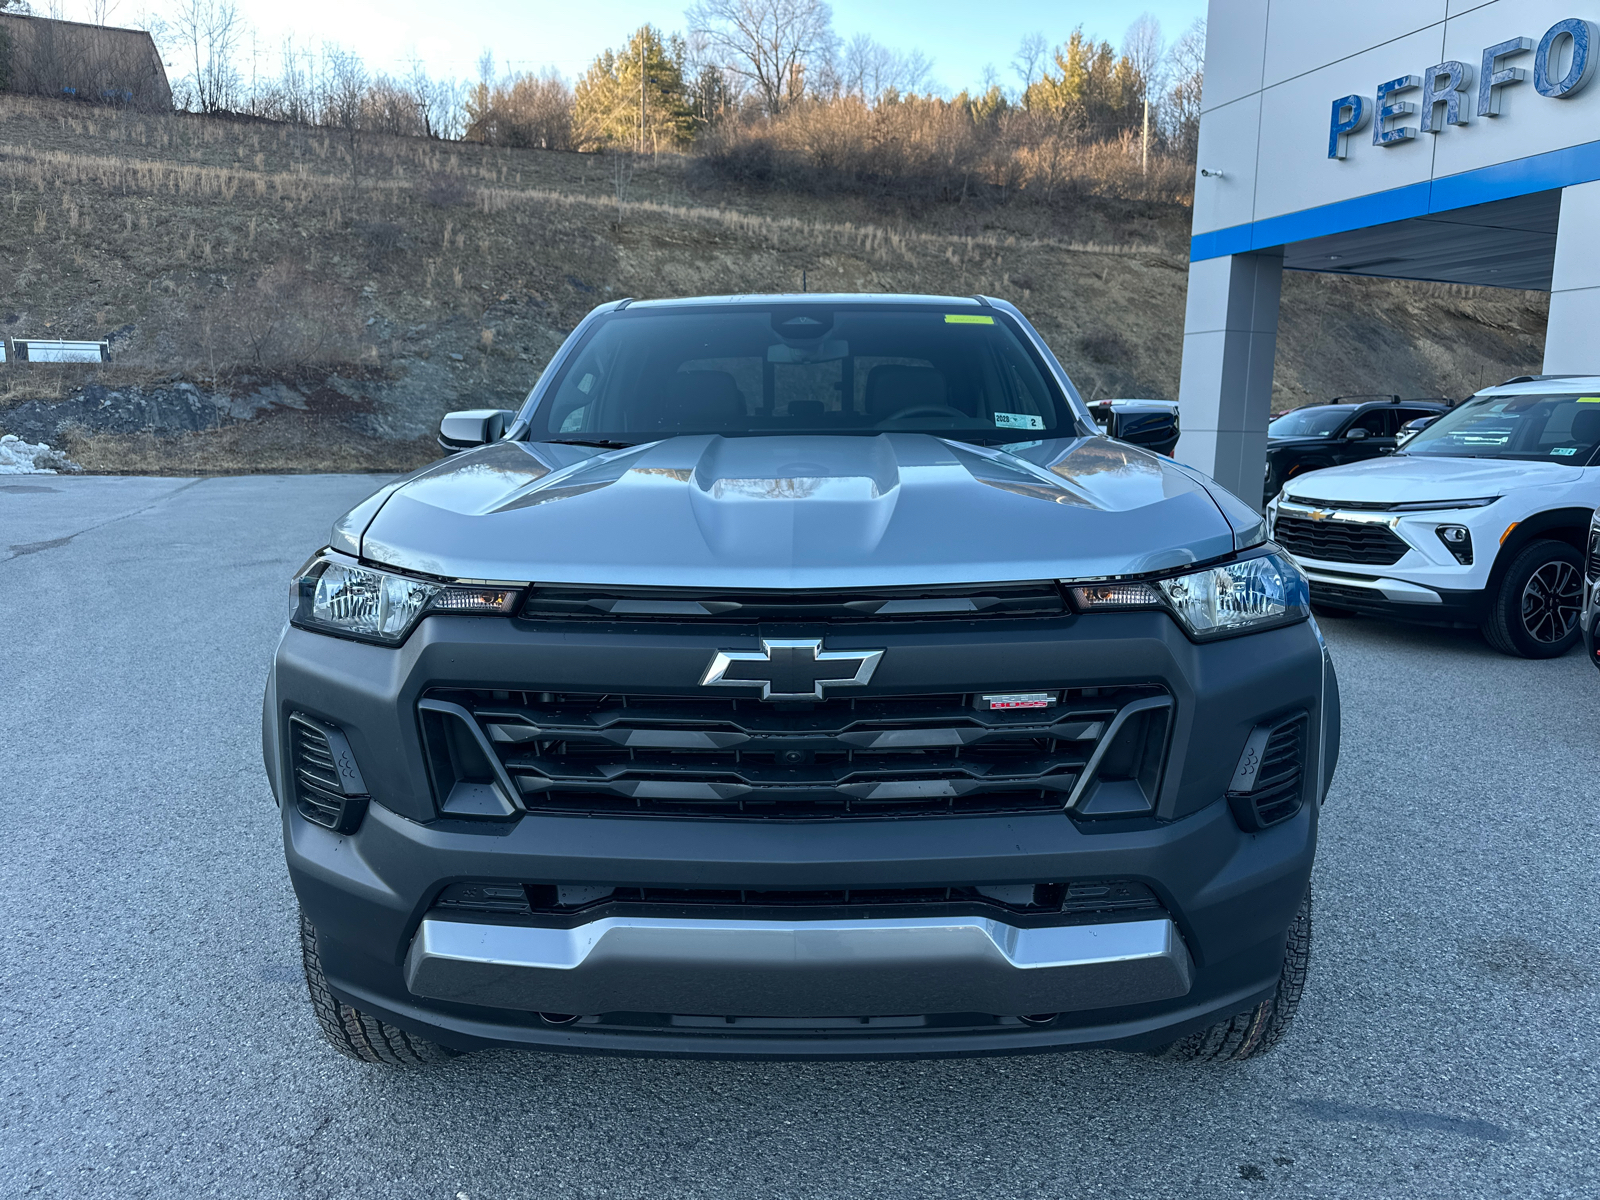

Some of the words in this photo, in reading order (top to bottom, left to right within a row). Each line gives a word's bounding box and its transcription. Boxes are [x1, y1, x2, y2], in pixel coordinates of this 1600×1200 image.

[1328, 17, 1599, 160] PERFO
[1030, 418, 1036, 427] 2
[990, 701, 1048, 709] BOSS
